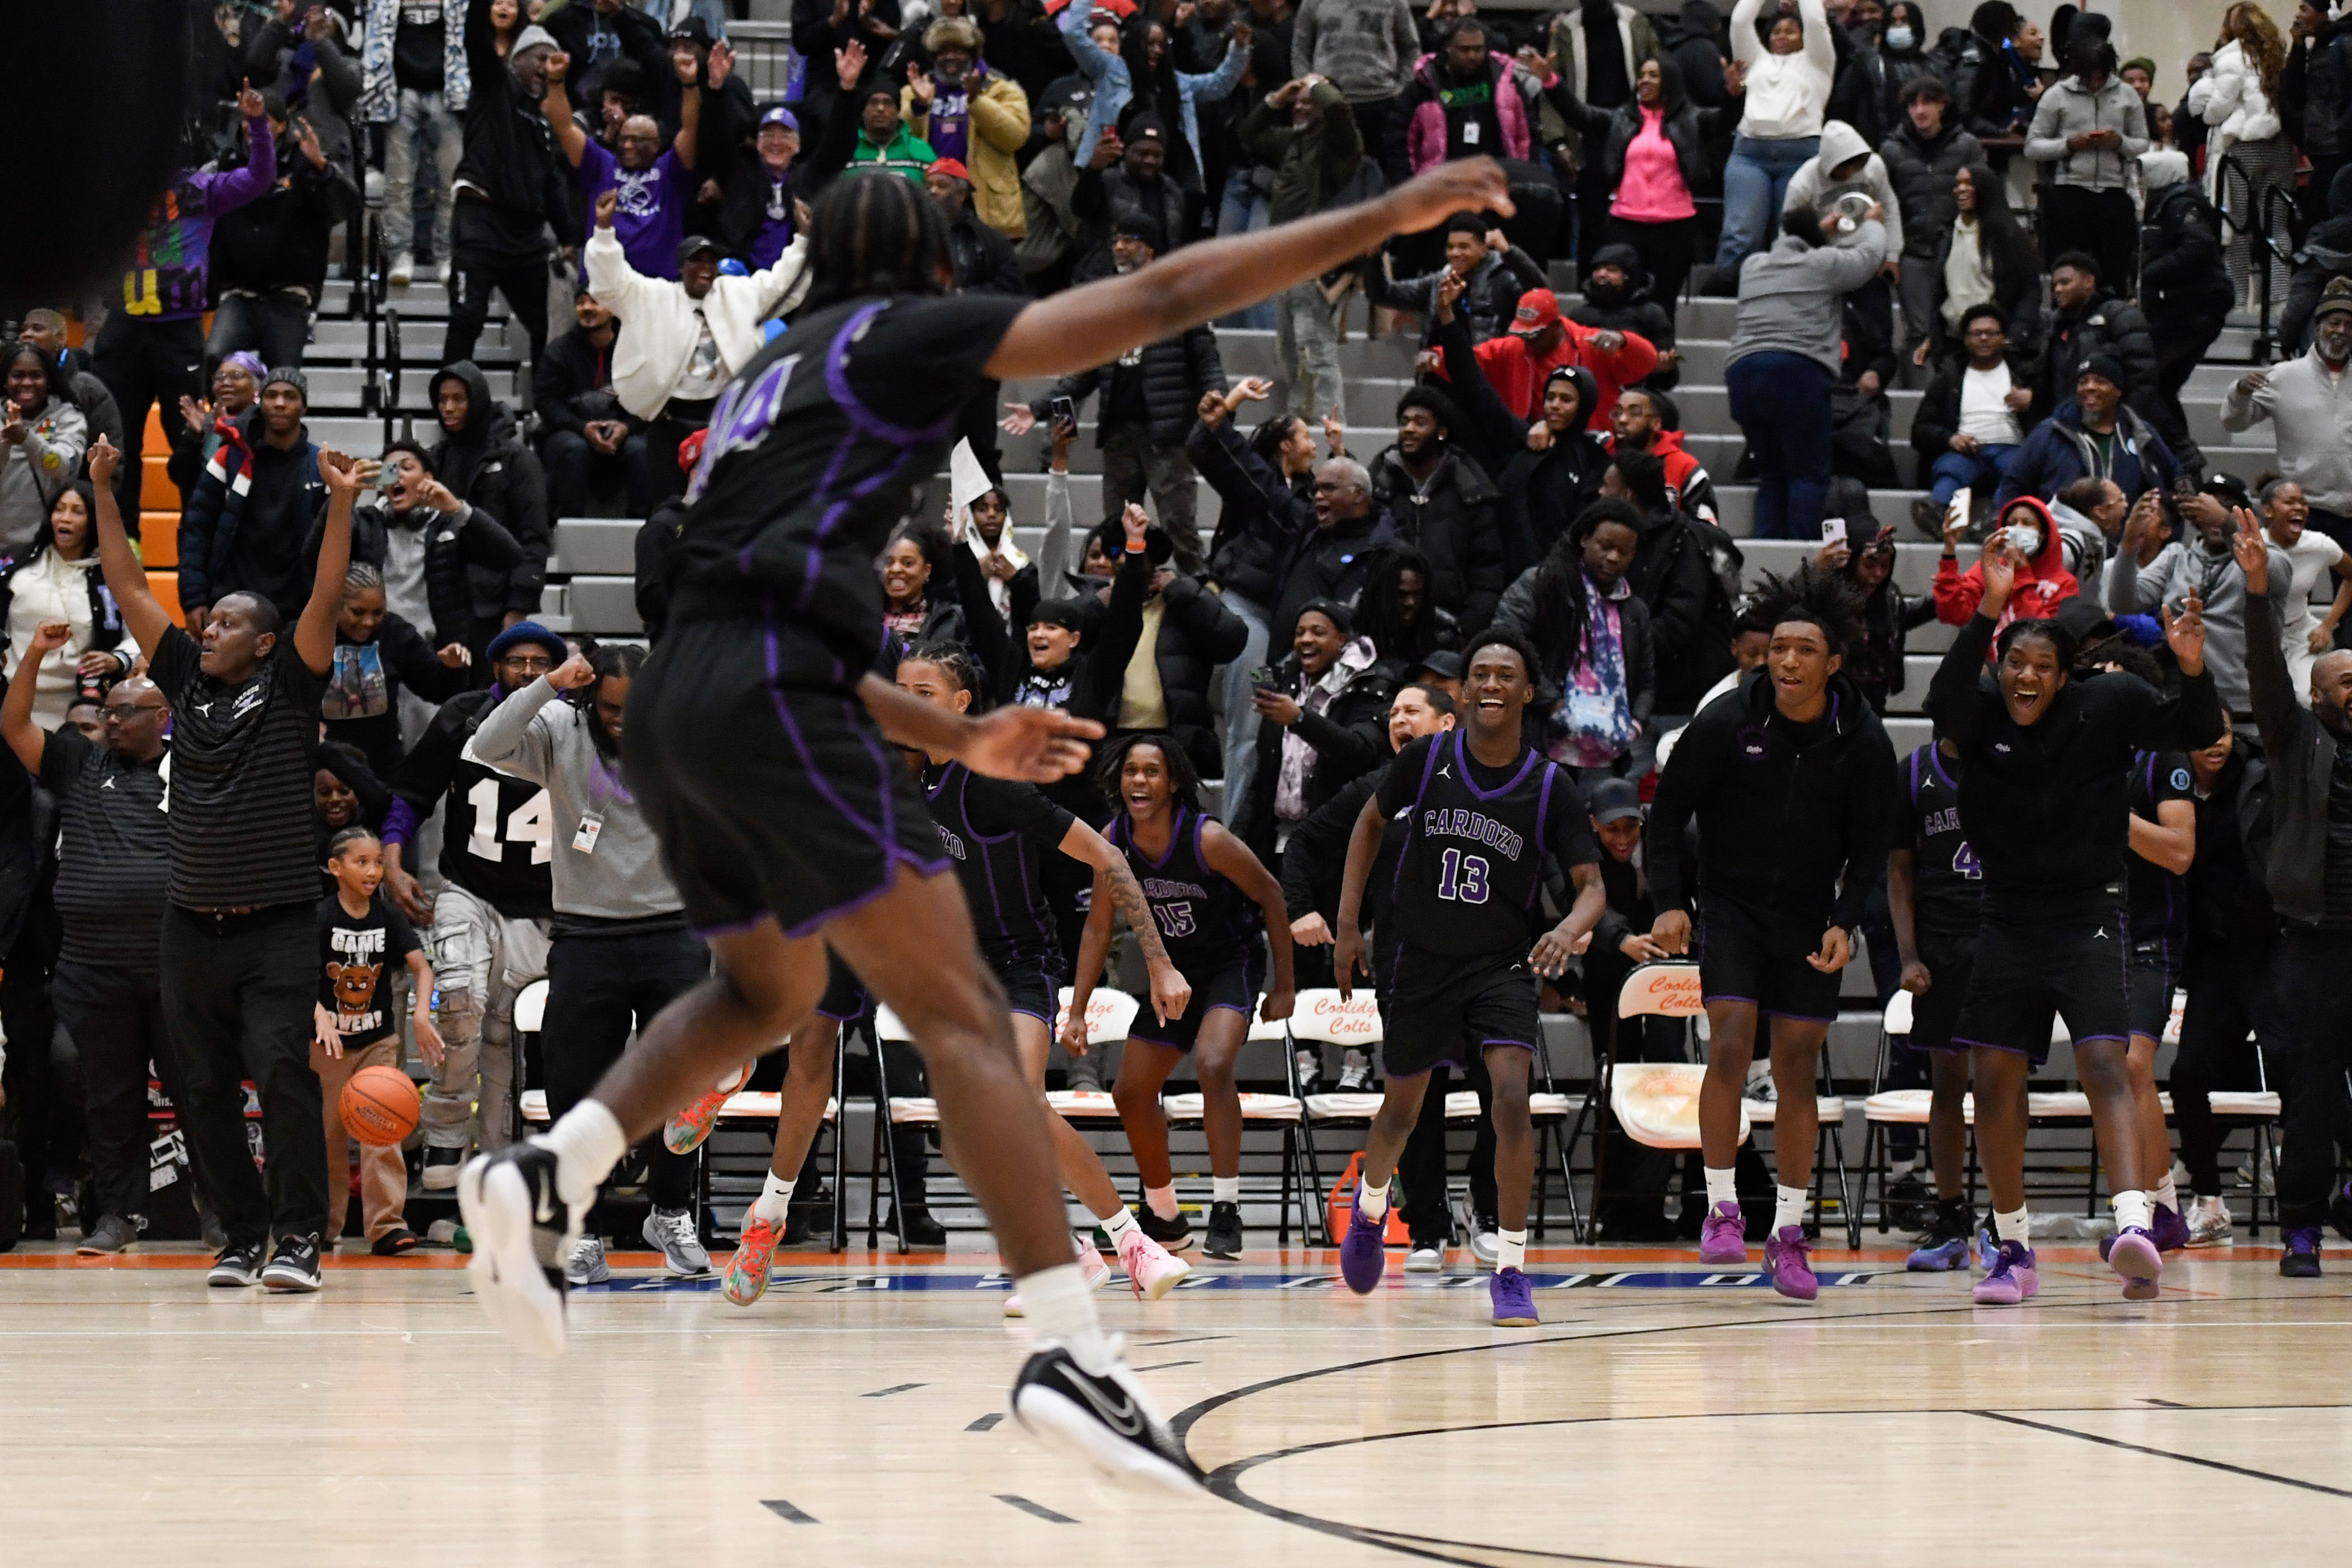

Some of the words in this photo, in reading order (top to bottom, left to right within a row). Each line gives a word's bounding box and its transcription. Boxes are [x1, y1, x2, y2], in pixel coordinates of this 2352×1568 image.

[232, 684, 259, 710] CARDOZO
[467, 777, 552, 865] 14
[1424, 809, 1523, 861] CARDOZO
[1438, 847, 1490, 904] 13
[1953, 841, 1982, 880] 4
[1153, 901, 1196, 938] 15
[331, 932, 386, 953] GAME
[1330, 1017, 1372, 1035] Colts
